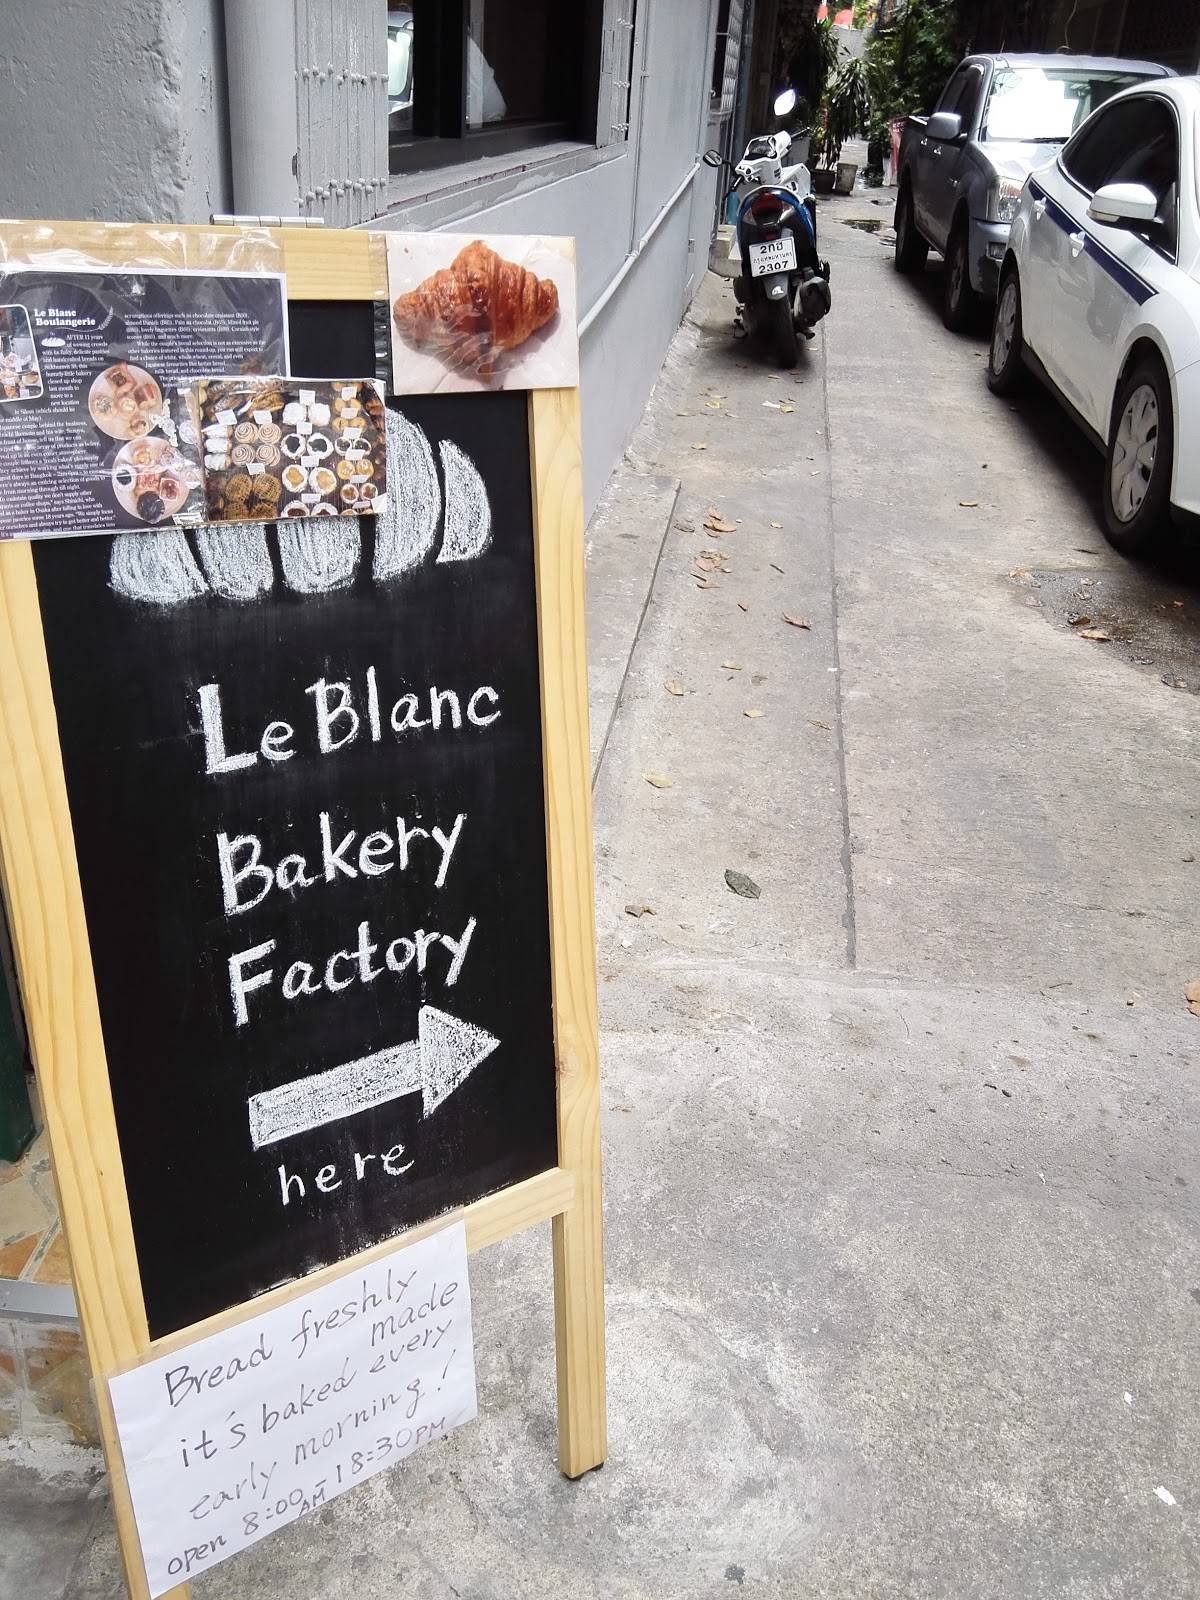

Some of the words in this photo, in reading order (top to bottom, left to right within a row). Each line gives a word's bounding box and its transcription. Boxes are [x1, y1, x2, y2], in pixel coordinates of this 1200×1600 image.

[759, 261, 788, 273] 2307
[34, 308, 46, 317] Le
[48, 308, 77, 317] Blanc
[36, 317, 96, 327] Boulangerie
[198, 683, 296, 774] Le
[305, 666, 500, 754] Blanc
[216, 811, 467, 917] Bakery
[228, 917, 477, 1028] Factory
[277, 1144, 414, 1206] here
[165, 1333, 272, 1407] Bread
[291, 1269, 417, 1359] freshly
[371, 1281, 458, 1347] made
[262, 1358, 357, 1433] baked
[369, 1319, 453, 1374] every
[190, 1461, 277, 1521] early
[168, 1535, 227, 1575] open
